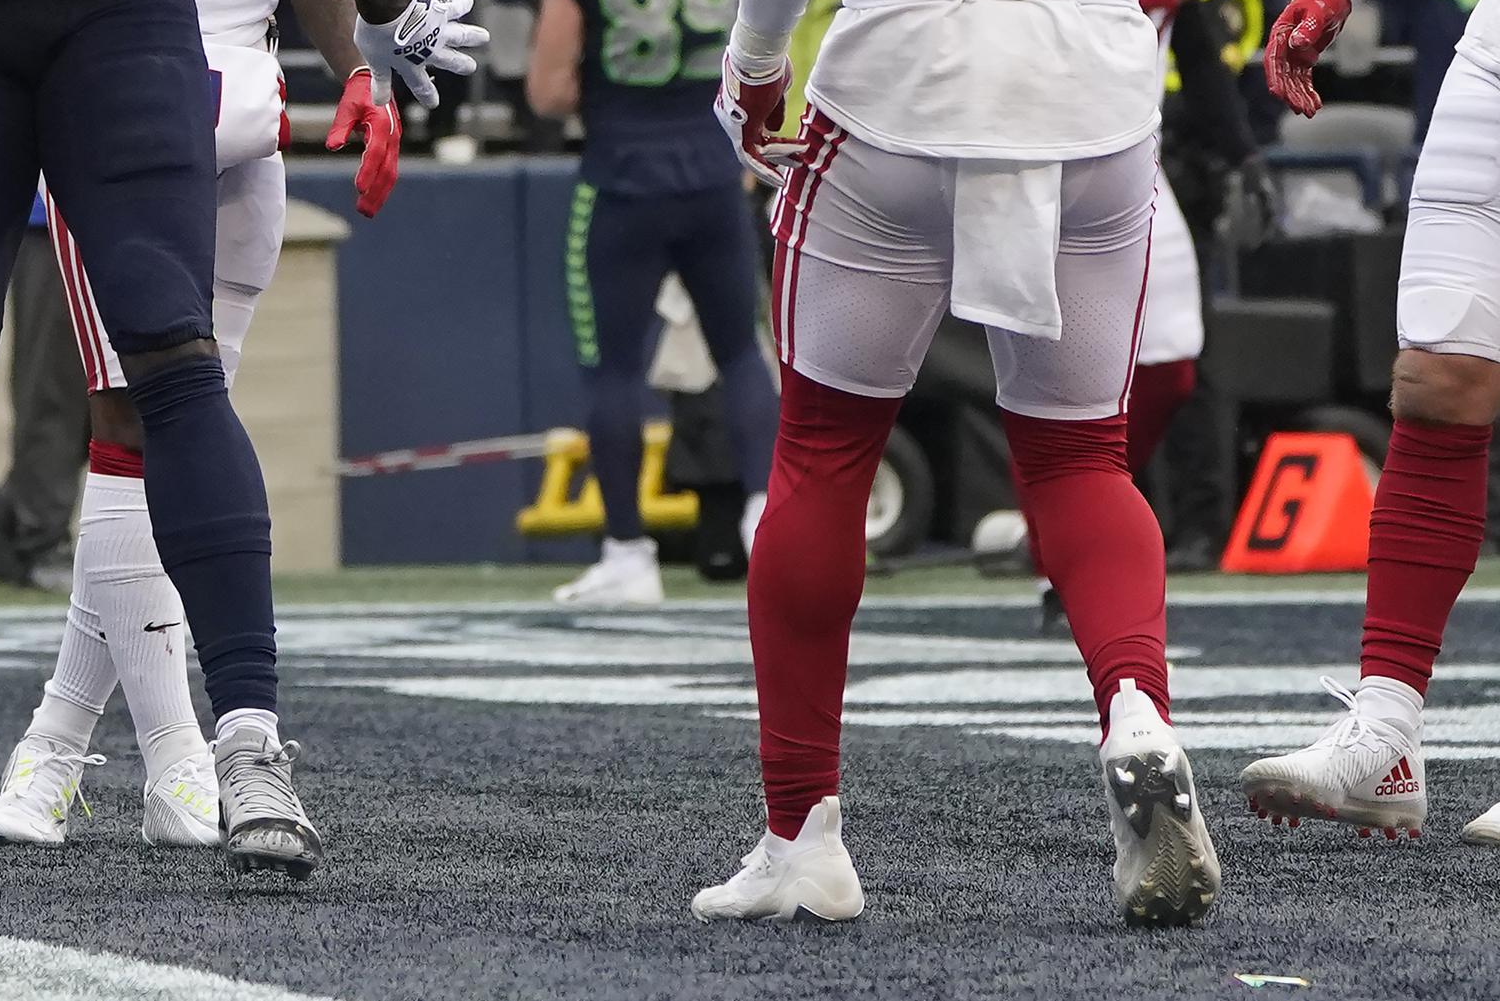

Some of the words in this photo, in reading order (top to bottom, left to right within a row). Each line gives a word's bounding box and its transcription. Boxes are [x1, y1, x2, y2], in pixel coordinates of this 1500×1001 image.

[393, 26, 440, 56] adidas
[1248, 455, 1321, 550] G
[1374, 780, 1420, 797] adidas
